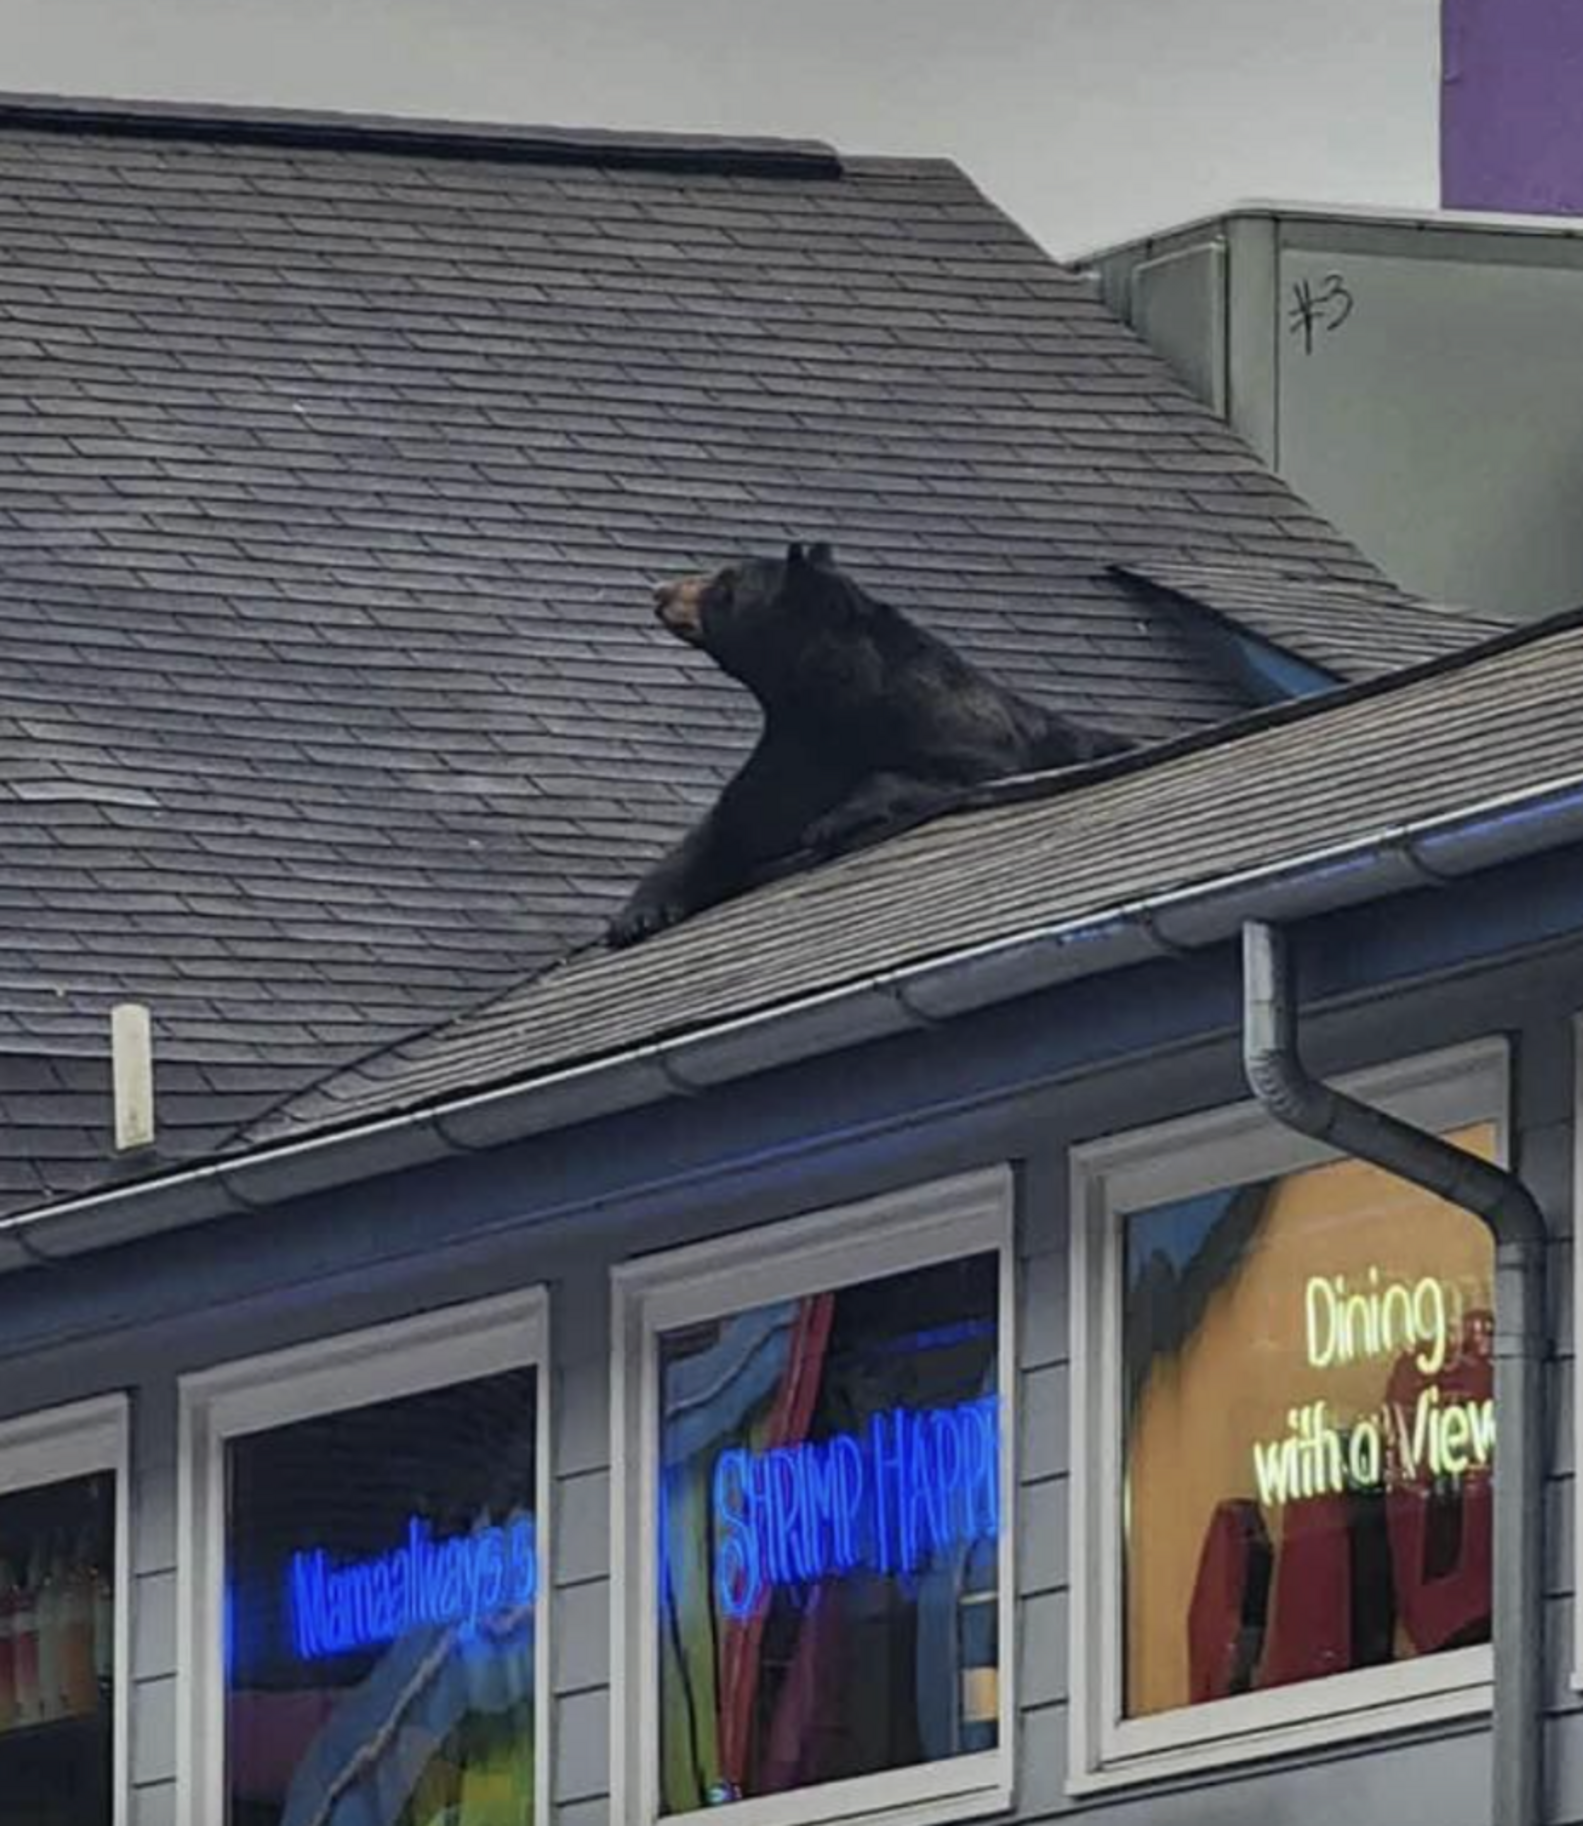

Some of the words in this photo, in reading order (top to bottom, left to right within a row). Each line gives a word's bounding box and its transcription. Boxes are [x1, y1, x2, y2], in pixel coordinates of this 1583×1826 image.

[1306, 1265, 1446, 1374] Dining
[1253, 1400, 1343, 1507] with
[1350, 1420, 1380, 1486] a
[1393, 1385, 1497, 1480] View
[713, 1432, 864, 1619] SHRIMP
